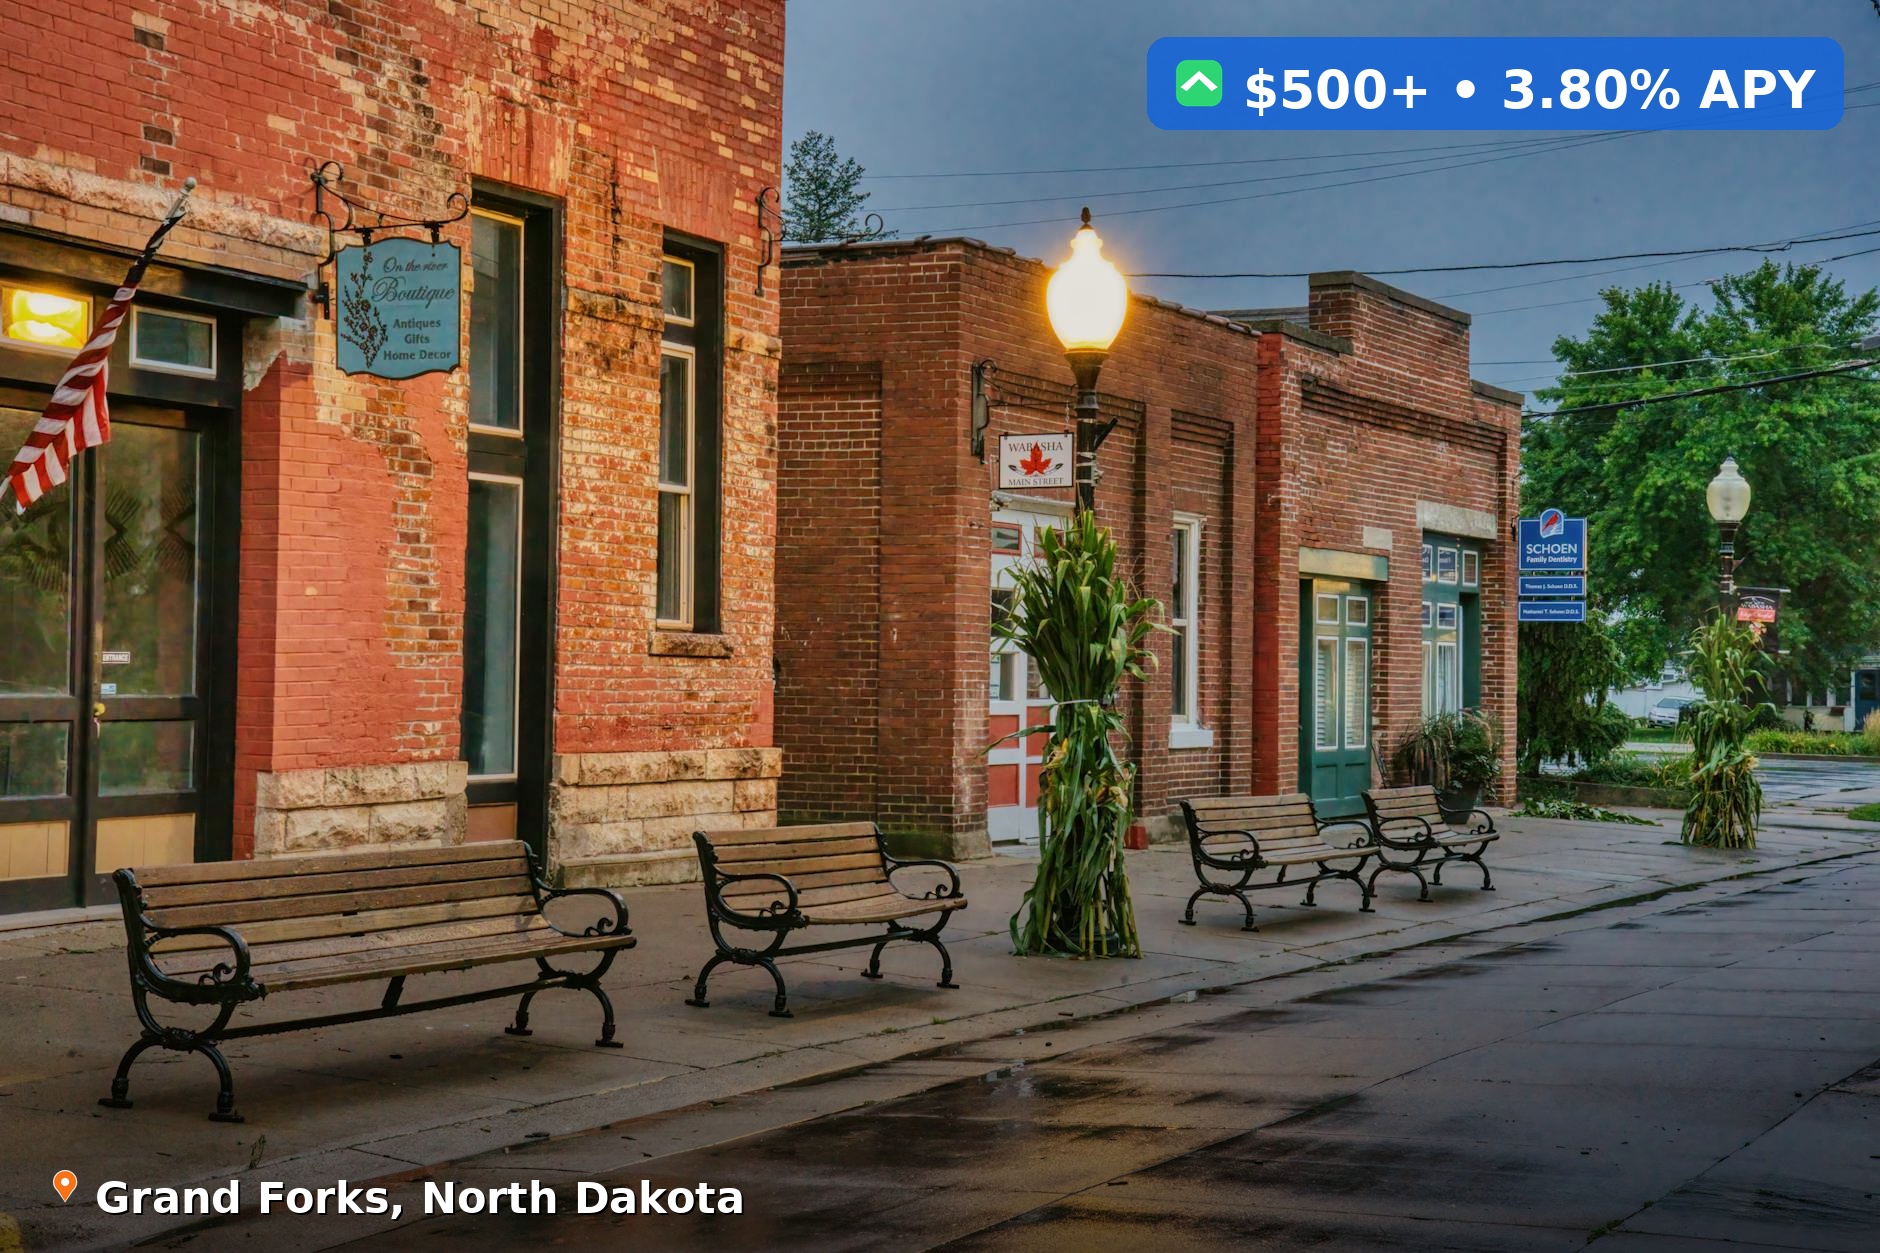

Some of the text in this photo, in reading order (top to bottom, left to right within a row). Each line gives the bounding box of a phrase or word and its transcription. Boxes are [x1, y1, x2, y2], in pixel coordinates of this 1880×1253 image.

[383, 256, 403, 273] On
[405, 259, 421, 272] the
[371, 276, 456, 309] Boutique
[393, 318, 441, 330] Antiques
[404, 333, 430, 345] Gifts
[383, 349, 451, 360] Home Decor
[1008, 441, 1064, 453] WABASHA
[1008, 477, 1065, 486] MAIN STREET
[1526, 543, 1578, 554] SCHOEN
[1526, 556, 1578, 564] Family Dentistry
